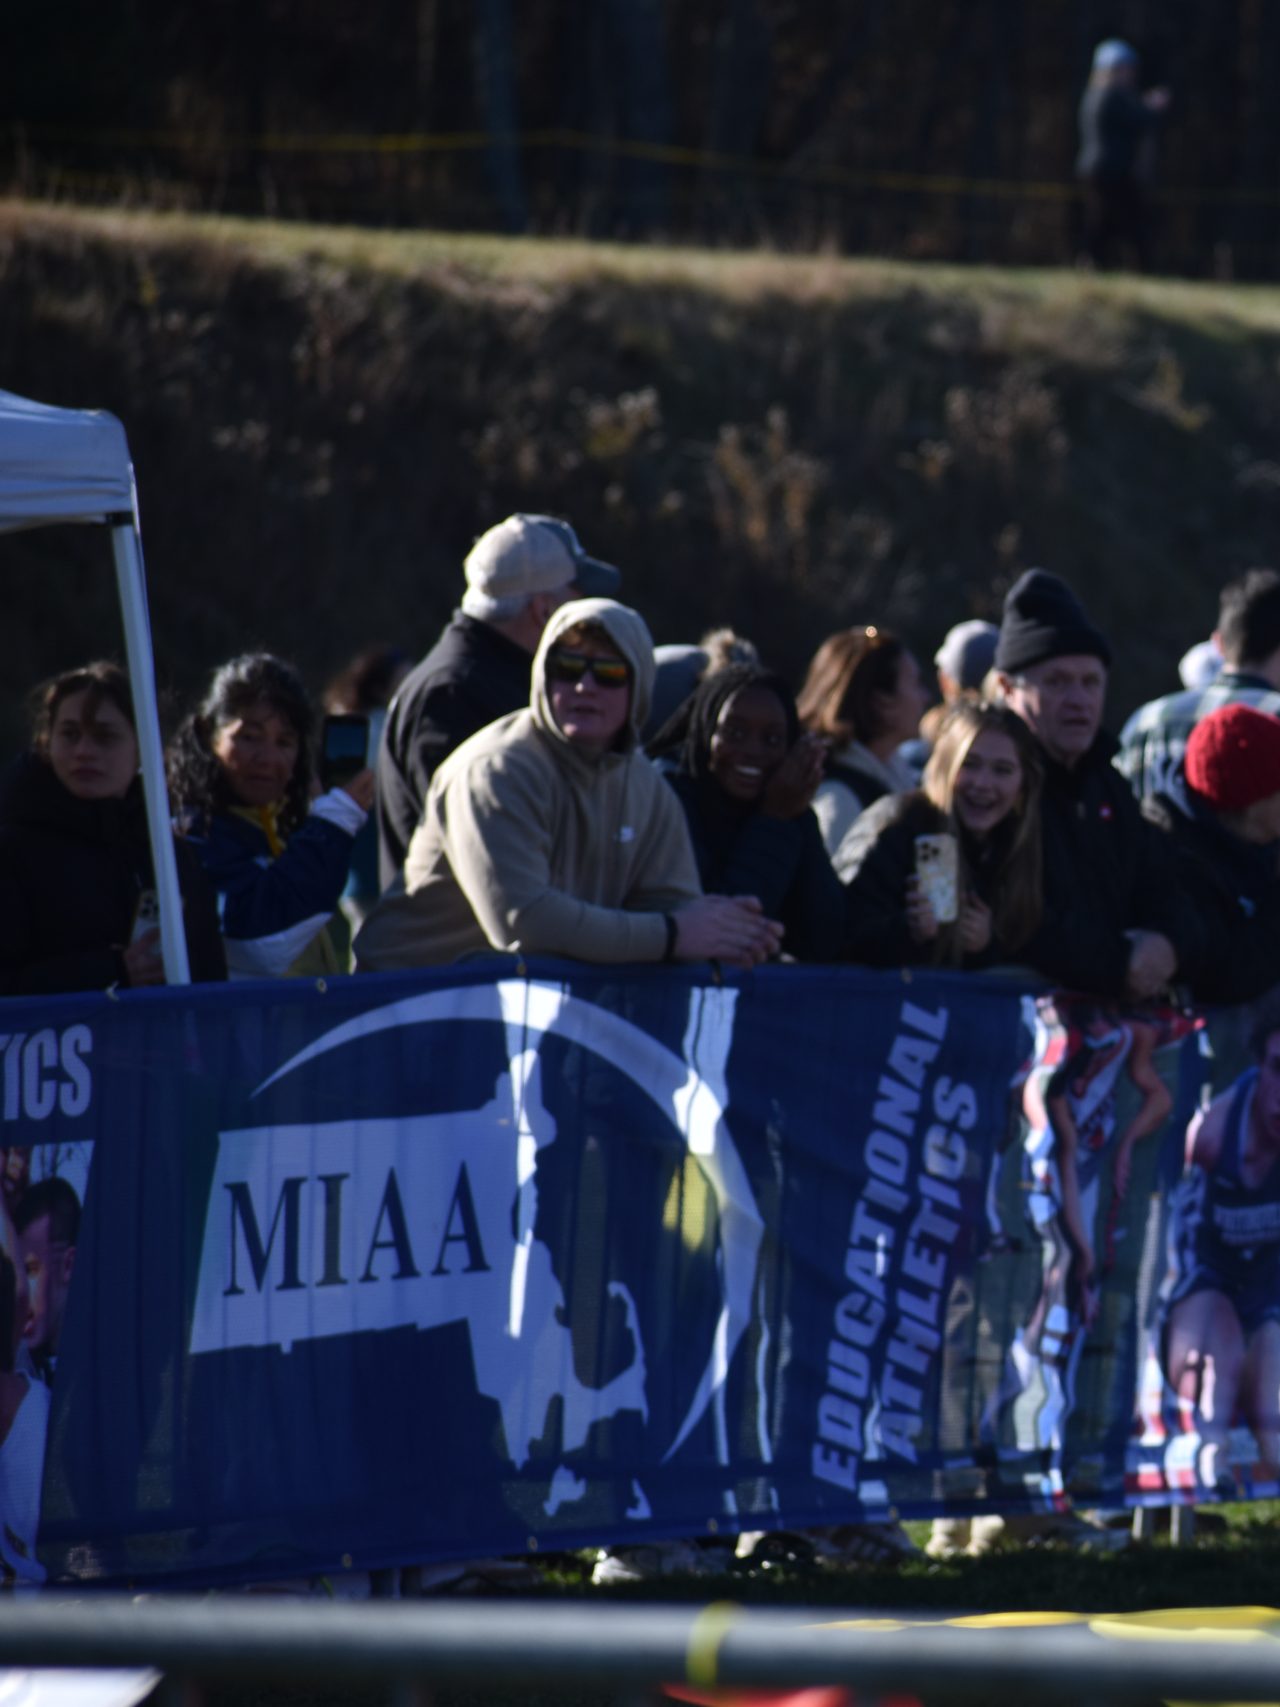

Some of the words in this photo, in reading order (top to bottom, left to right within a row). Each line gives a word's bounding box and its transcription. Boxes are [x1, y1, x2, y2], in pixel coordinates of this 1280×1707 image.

[223, 1160, 491, 1296] MIAA
[811, 1001, 949, 1491] EDUCATIONAL
[879, 1075, 979, 1465] ATHLETICS
